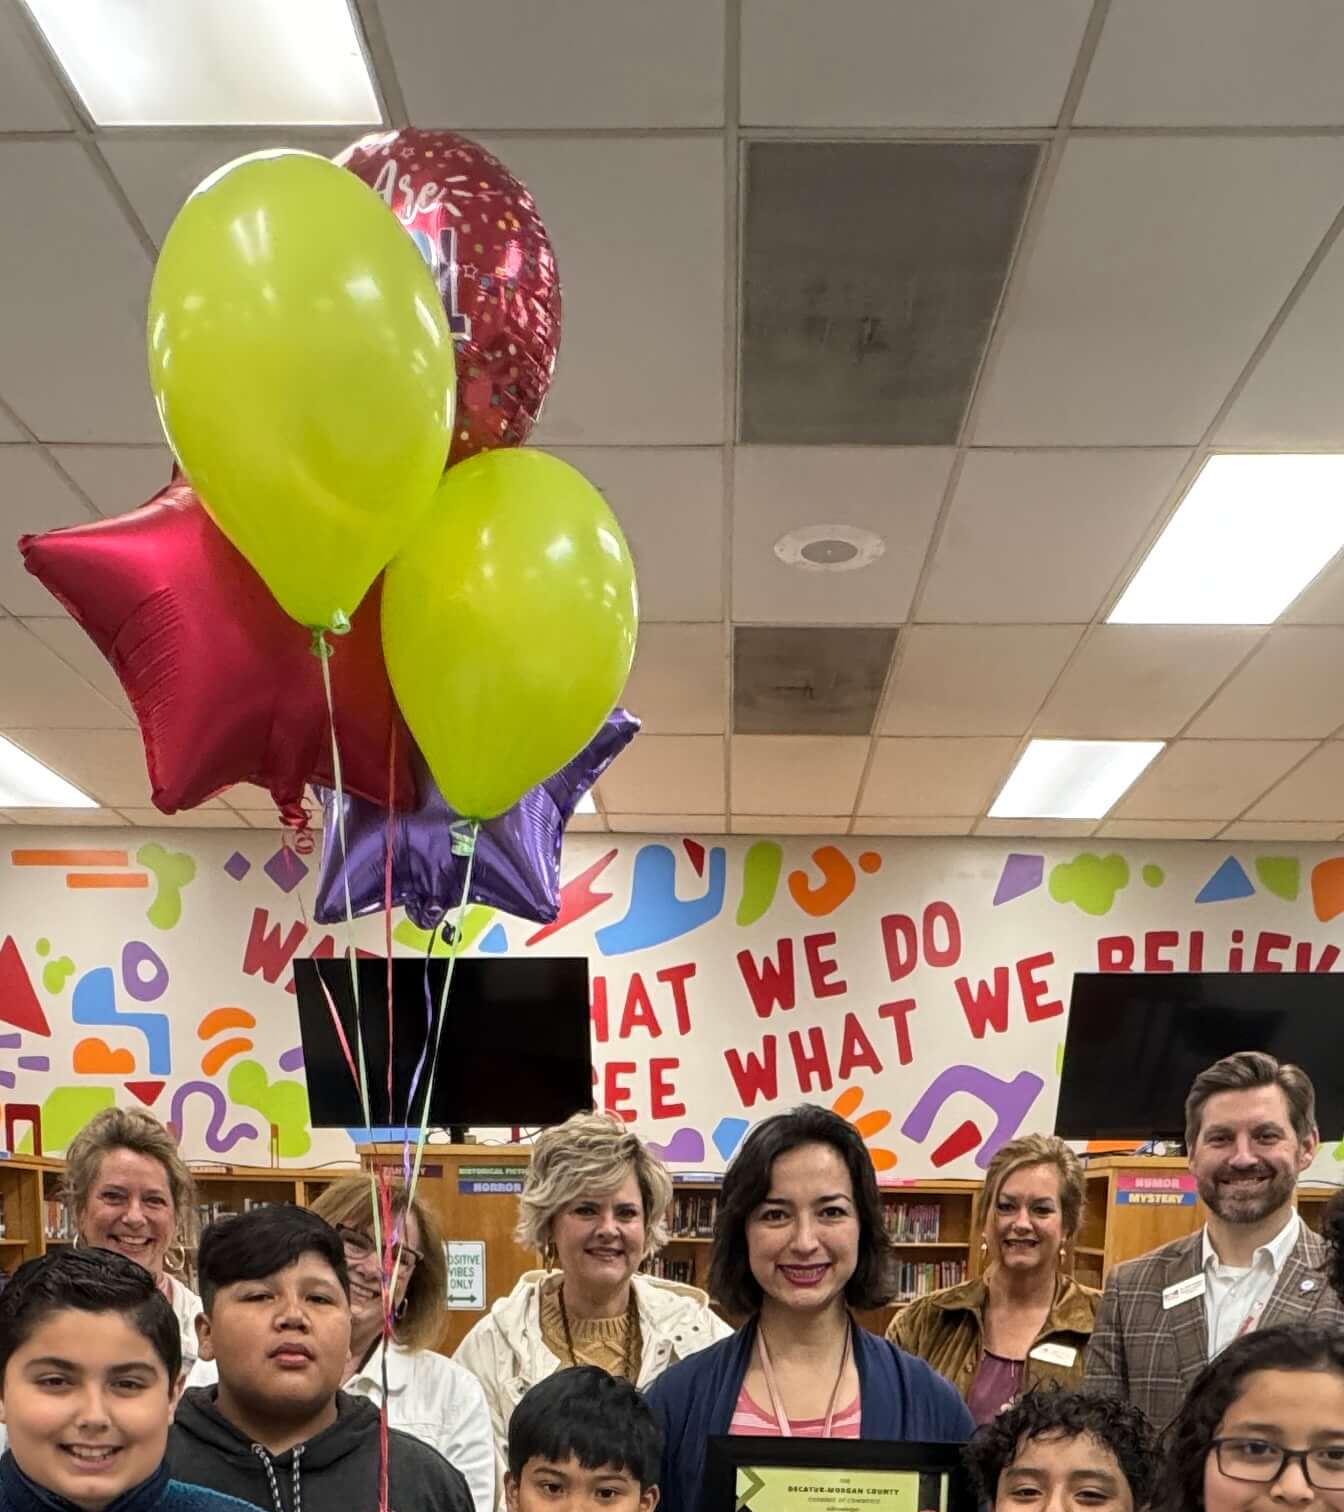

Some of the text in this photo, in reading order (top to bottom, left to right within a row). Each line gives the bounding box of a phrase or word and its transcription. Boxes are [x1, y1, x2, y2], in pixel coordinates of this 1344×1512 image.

[591, 962, 697, 1042] HAT
[737, 931, 847, 1018] WE
[881, 901, 962, 982] DO
[592, 1057, 686, 1123] EE
[724, 998, 917, 1107] WHAT
[954, 951, 1065, 1039] WE
[473, 1183, 522, 1193] HORROR
[1135, 1177, 1181, 1189] HUMOR
[1128, 1192, 1185, 1204] MYSTERY
[450, 1279, 474, 1289] ONLY
